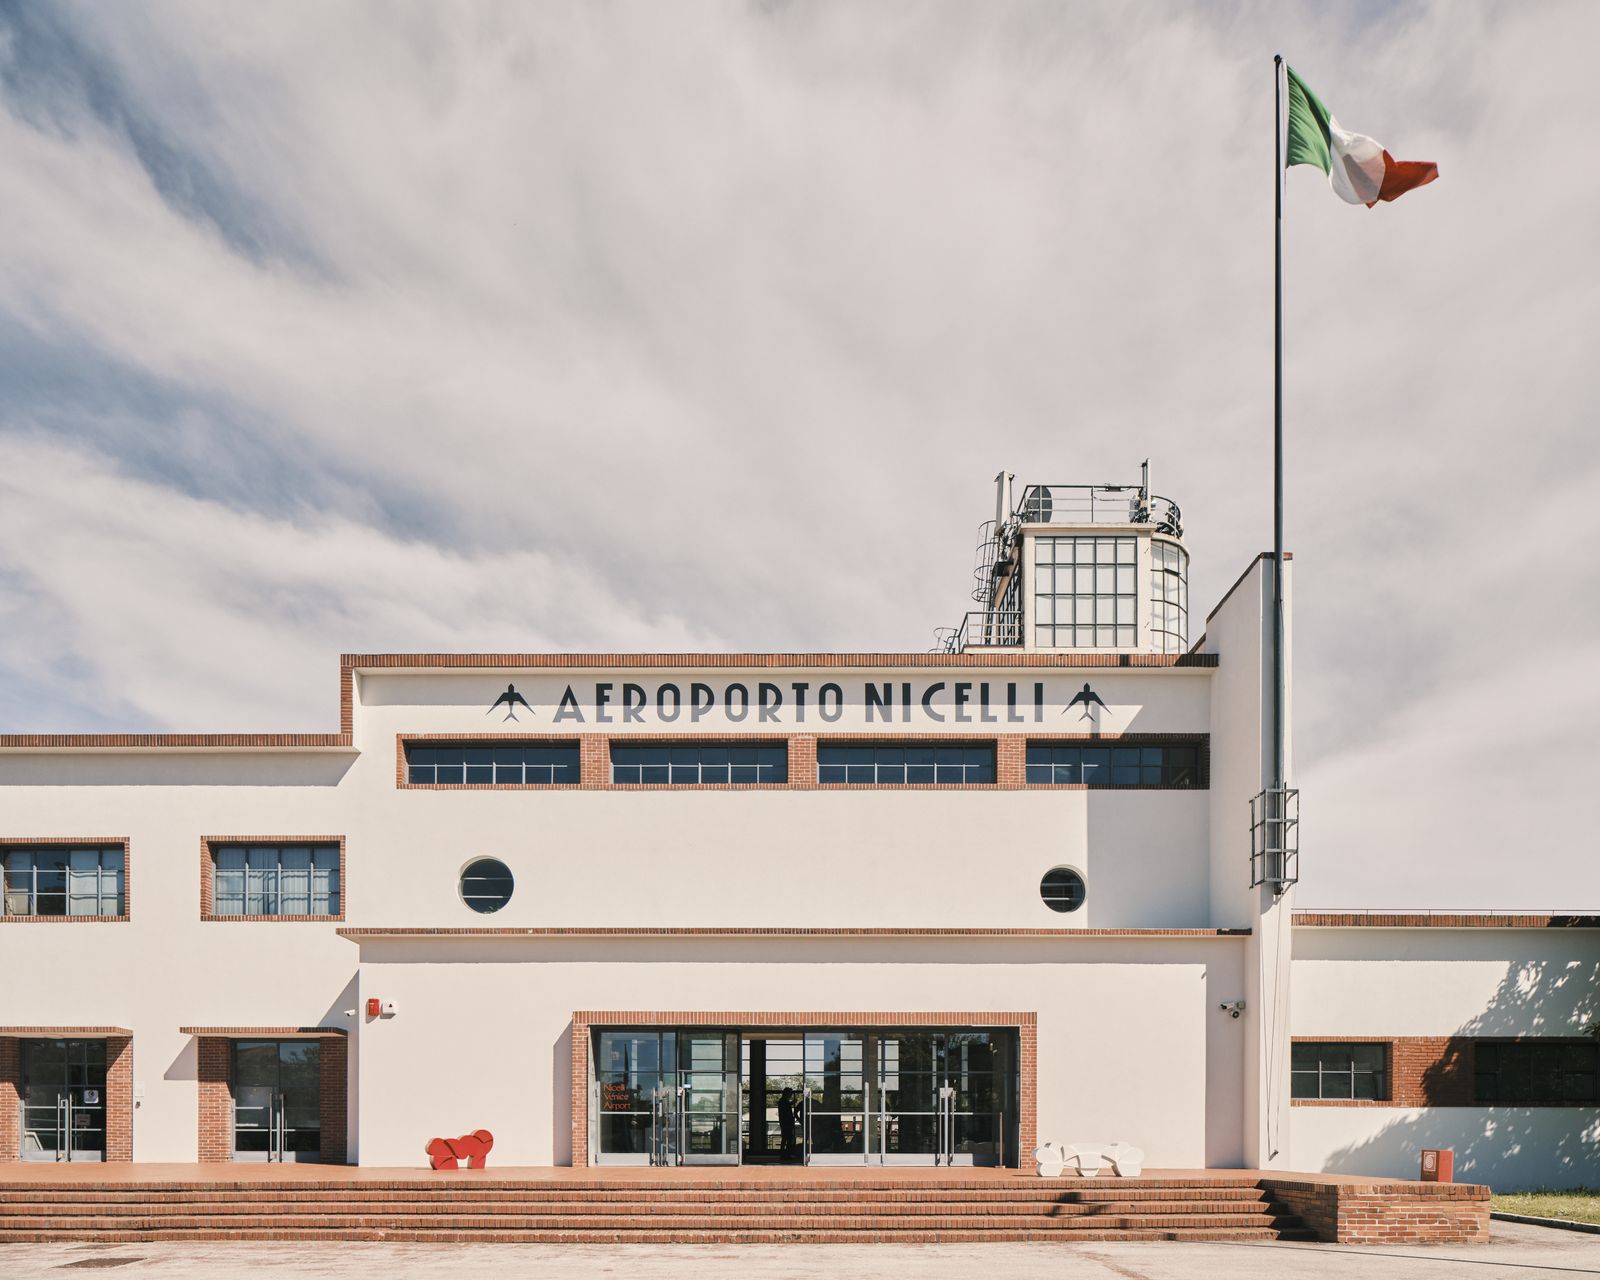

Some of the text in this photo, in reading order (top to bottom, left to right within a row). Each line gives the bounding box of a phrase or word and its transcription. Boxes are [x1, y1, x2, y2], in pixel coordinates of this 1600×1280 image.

[552, 682, 1043, 723] AEROPORTO NICELLI
[603, 1093, 629, 1101] Venice
[603, 1101, 631, 1110] Airport
